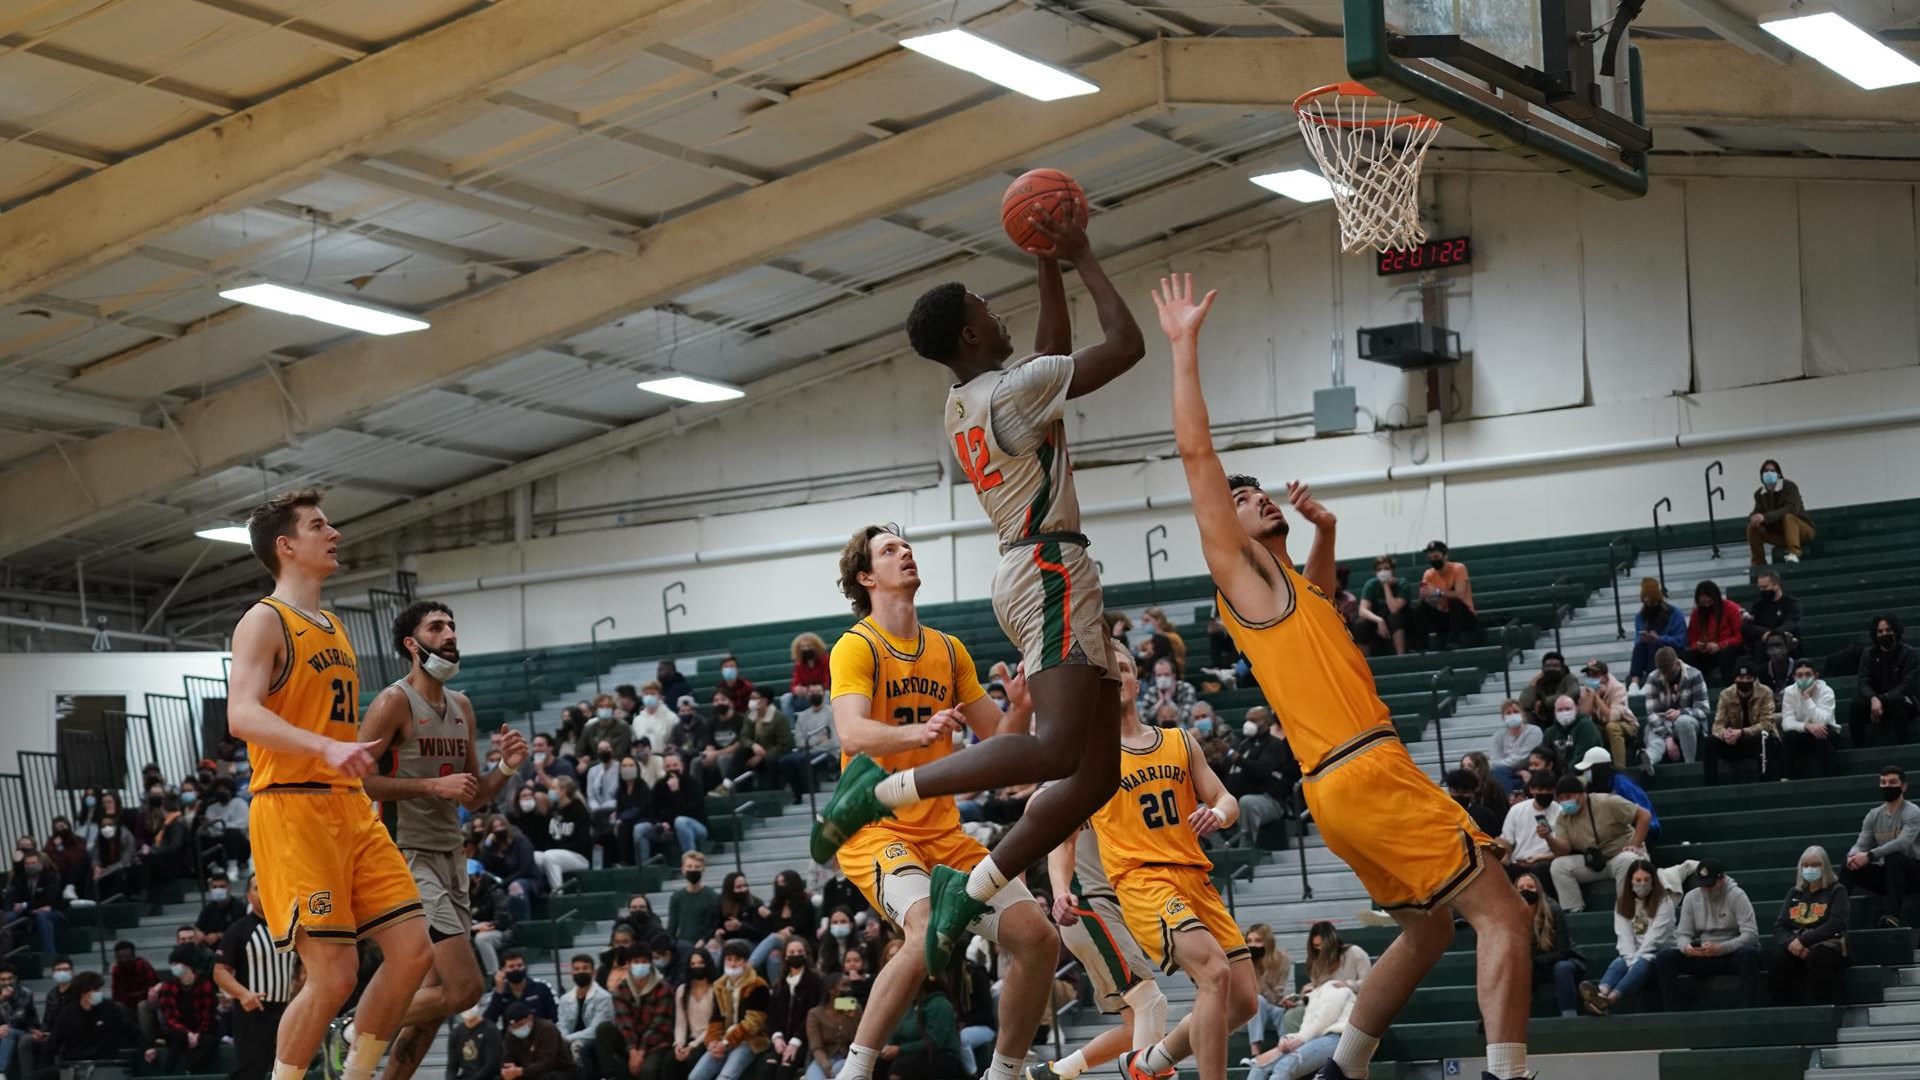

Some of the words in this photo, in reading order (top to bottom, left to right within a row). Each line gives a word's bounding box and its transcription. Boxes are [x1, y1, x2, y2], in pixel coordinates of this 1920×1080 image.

[330, 678, 355, 723] 21
[1120, 764, 1186, 793] WARRIORS
[1139, 789, 1180, 830] 20
